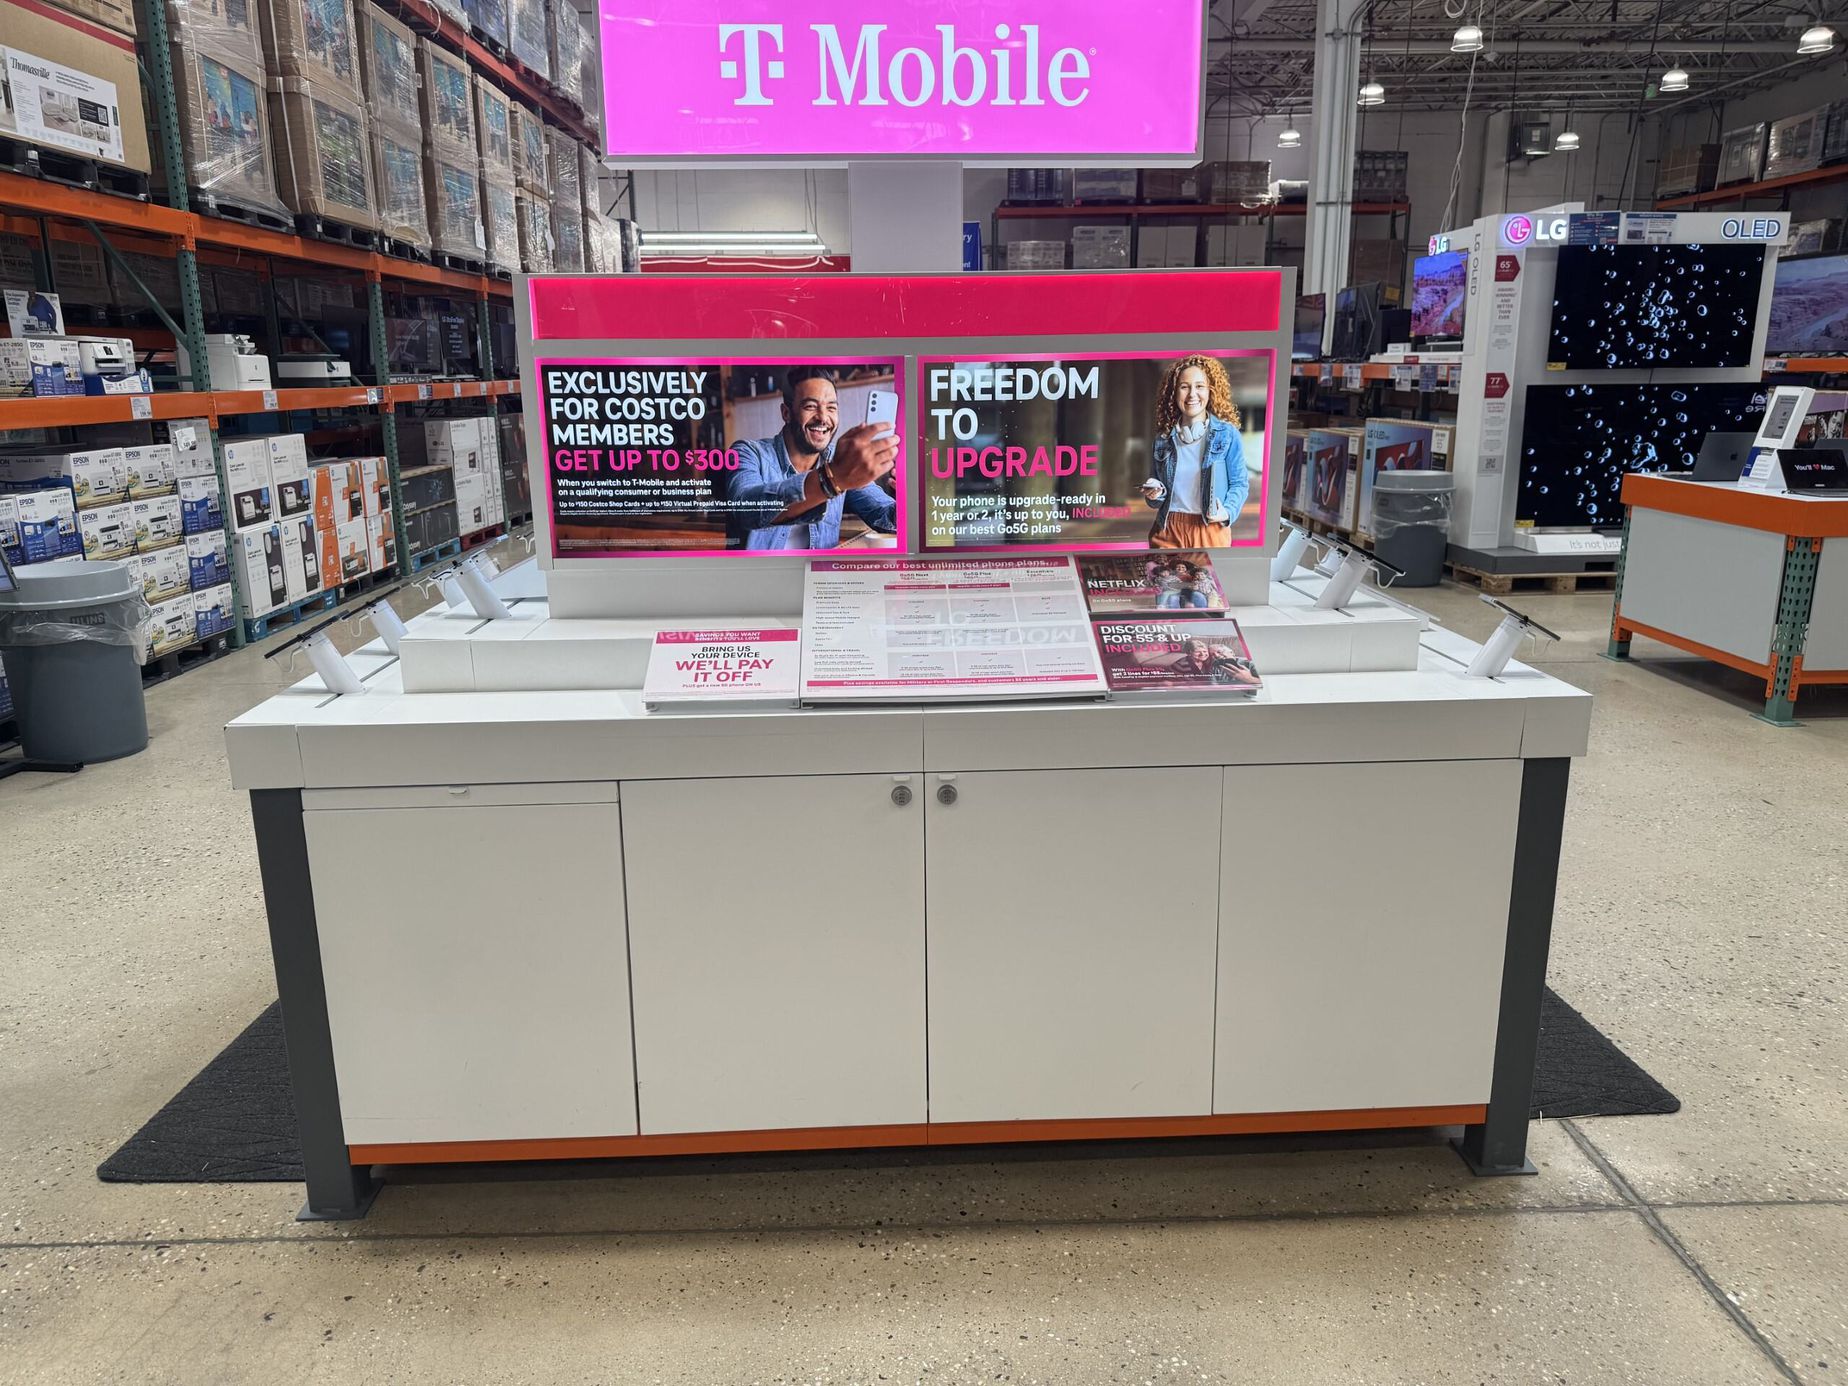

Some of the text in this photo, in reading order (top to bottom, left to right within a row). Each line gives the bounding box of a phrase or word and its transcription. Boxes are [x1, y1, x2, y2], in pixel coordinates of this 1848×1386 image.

[718, 23, 1091, 107] T Mobile
[1536, 219, 1567, 240] LG
[1721, 219, 1781, 240] OLED
[547, 371, 708, 395] EXCLUSIVELY
[930, 366, 1100, 402] FREEDOM
[550, 396, 706, 421] FOR COSTCO
[931, 407, 979, 441] TO
[552, 423, 675, 447] MEMBERS
[72, 456, 90, 465] EPSON
[125, 450, 141, 459] EPSON
[555, 449, 740, 472] GET UP TO $300
[931, 445, 1099, 480] UPGRADE
[557, 478, 712, 490] When you switch to T-Mobile and activate
[558, 488, 567, 497] on
[574, 487, 612, 498] qualifying
[614, 488, 651, 497] consumer
[652, 488, 660, 496] or
[662, 486, 694, 496] business
[695, 486, 712, 498] plan
[18, 497, 36, 506] EPSON
[559, 501, 568, 509] Up
[609, 501, 623, 509] Shop
[673, 500, 692, 508] Virtual
[693, 500, 714, 509] Prepaid
[714, 500, 727, 508] Visa
[727, 500, 741, 508] Card
[757, 500, 784, 509] activating
[932, 493, 1106, 509] Your phone is upgrade-ready in
[134, 504, 149, 512] EPSON
[82, 512, 98, 522] EPSON
[932, 510, 938, 520] 1
[939, 511, 965, 523] year
[981, 509, 992, 521] 2,
[994, 508, 1012, 519] it's
[1014, 509, 1029, 521] up
[1031, 508, 1041, 518] to
[1043, 509, 1070, 521] you,
[932, 521, 1062, 536] on our best Go5G plans
[1585, 540, 1601, 549] not
[1602, 539, 1620, 551] just
[141, 555, 157, 564] EPSON
[832, 562, 881, 571] Compare
[902, 561, 926, 569] best
[928, 560, 979, 570] unlimited
[981, 558, 1015, 569] phone
[1087, 579, 1146, 588] NETFLIX
[1101, 624, 1177, 634] DISCOUNT
[1102, 633, 1191, 644] FOR 55 & UP
[701, 645, 734, 653] BRING
[722, 651, 761, 659] DEVICE
[676, 658, 774, 671] WE'LL PAY
[693, 671, 753, 683] IT OFF
